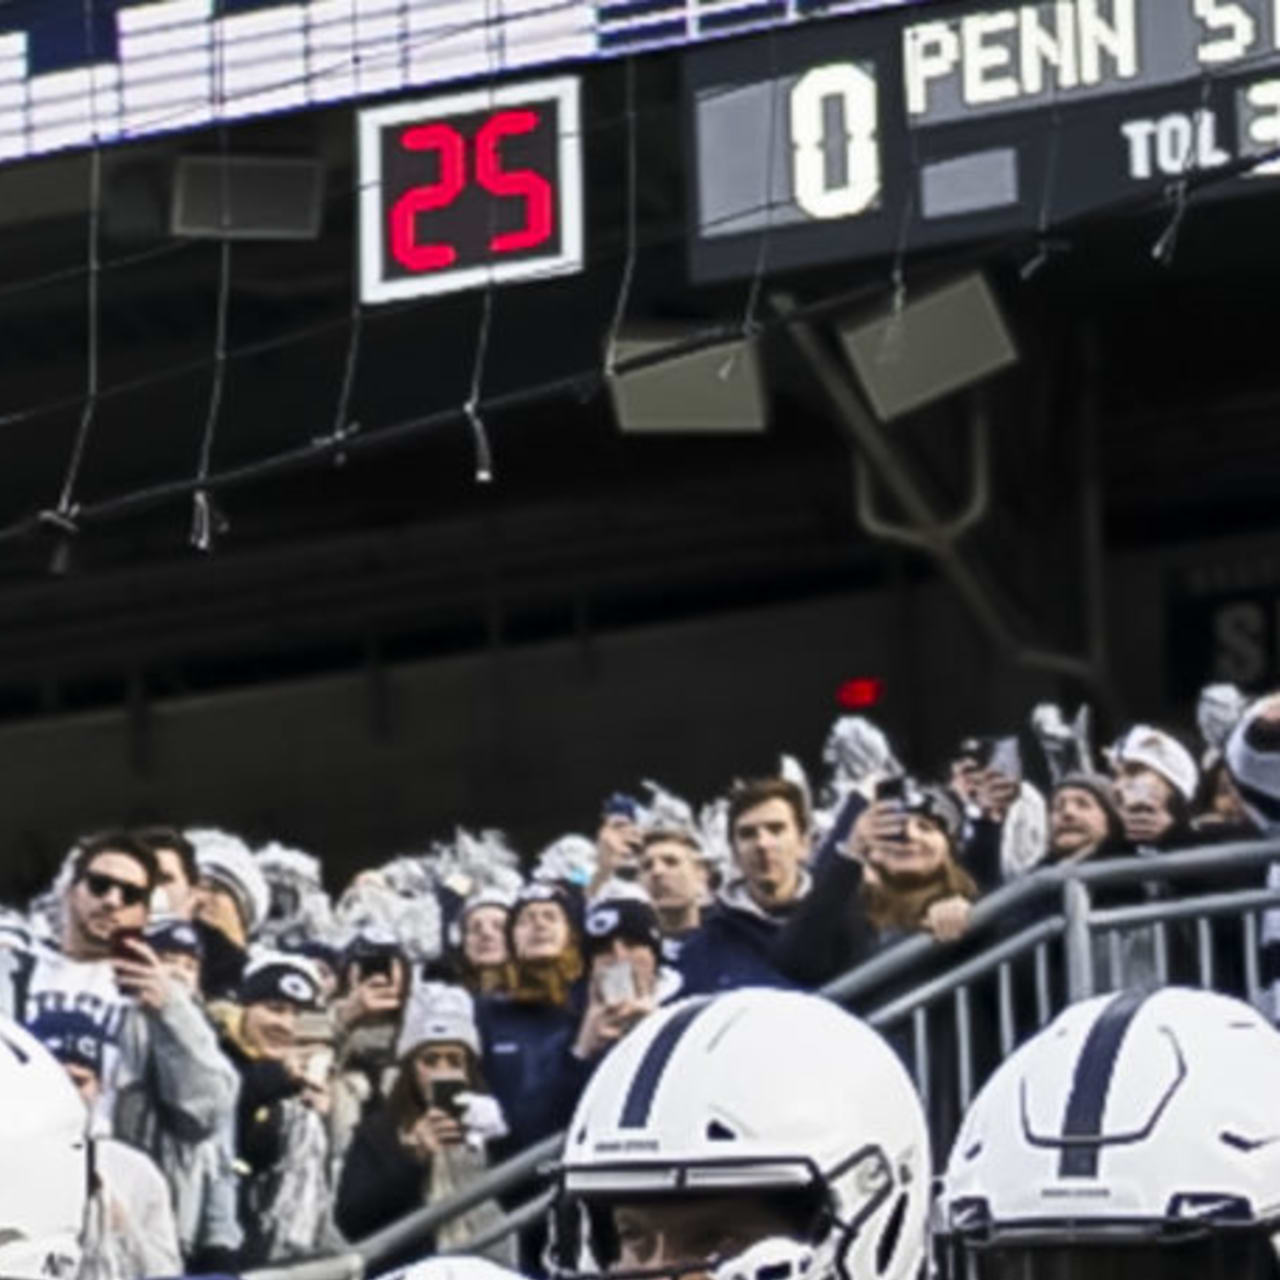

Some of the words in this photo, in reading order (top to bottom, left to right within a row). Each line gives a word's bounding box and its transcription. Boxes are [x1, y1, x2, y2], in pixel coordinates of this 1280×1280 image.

[903, 0, 1137, 114] PENN
[1194, 0, 1280, 62] S
[389, 109, 554, 273] 25
[789, 62, 881, 218] 0
[1120, 108, 1230, 180] TOL
